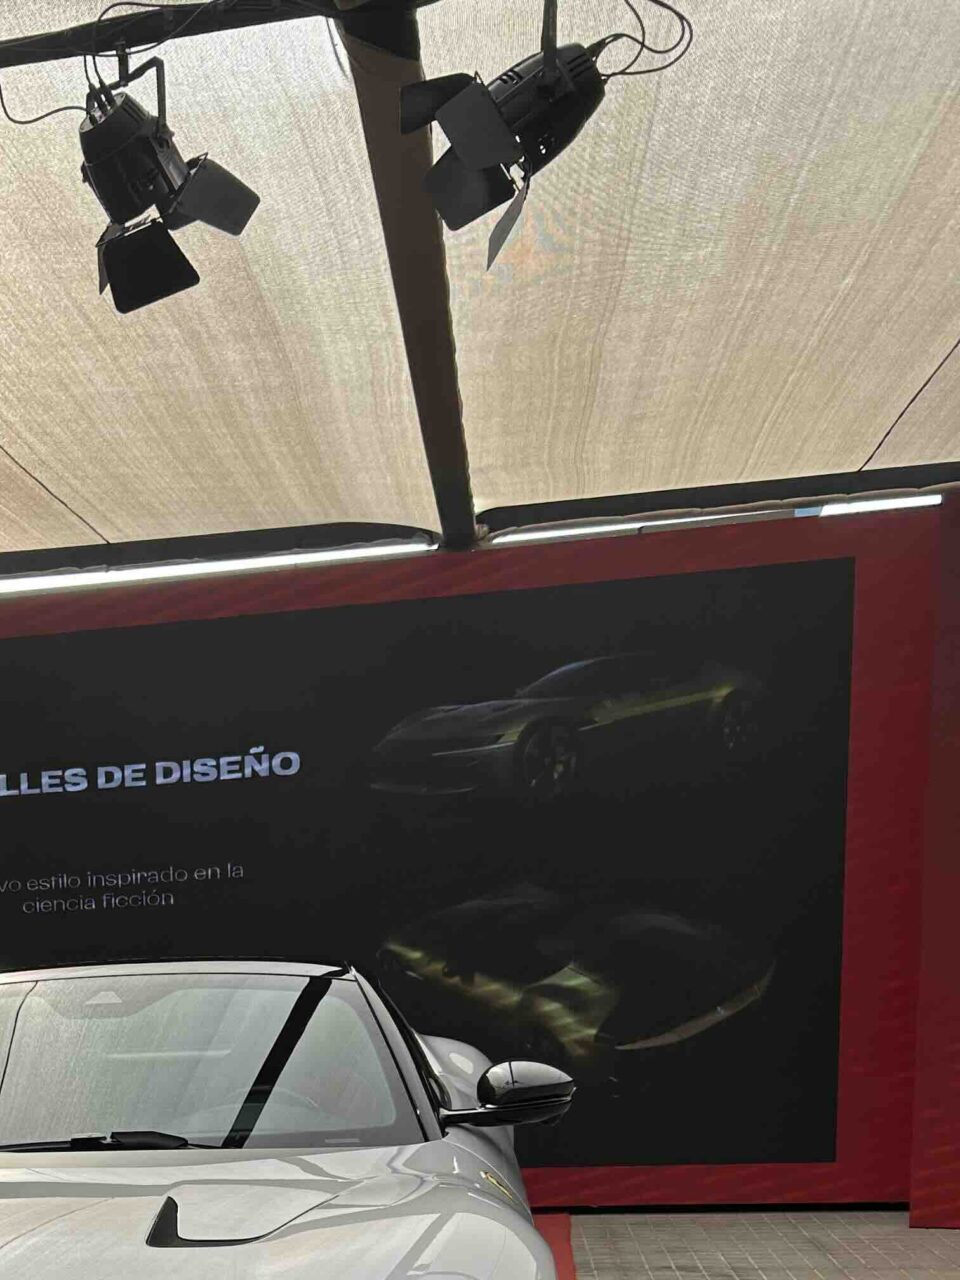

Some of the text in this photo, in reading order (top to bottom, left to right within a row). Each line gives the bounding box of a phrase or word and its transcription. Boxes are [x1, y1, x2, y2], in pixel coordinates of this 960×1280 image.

[97, 763, 147, 789] DE
[155, 745, 301, 785] DISEÑO
[26, 873, 81, 892] estilo
[87, 866, 188, 891] inspirado
[193, 865, 221, 881] en
[227, 862, 244, 878] la
[22, 888, 175, 914] ciencia ficción
